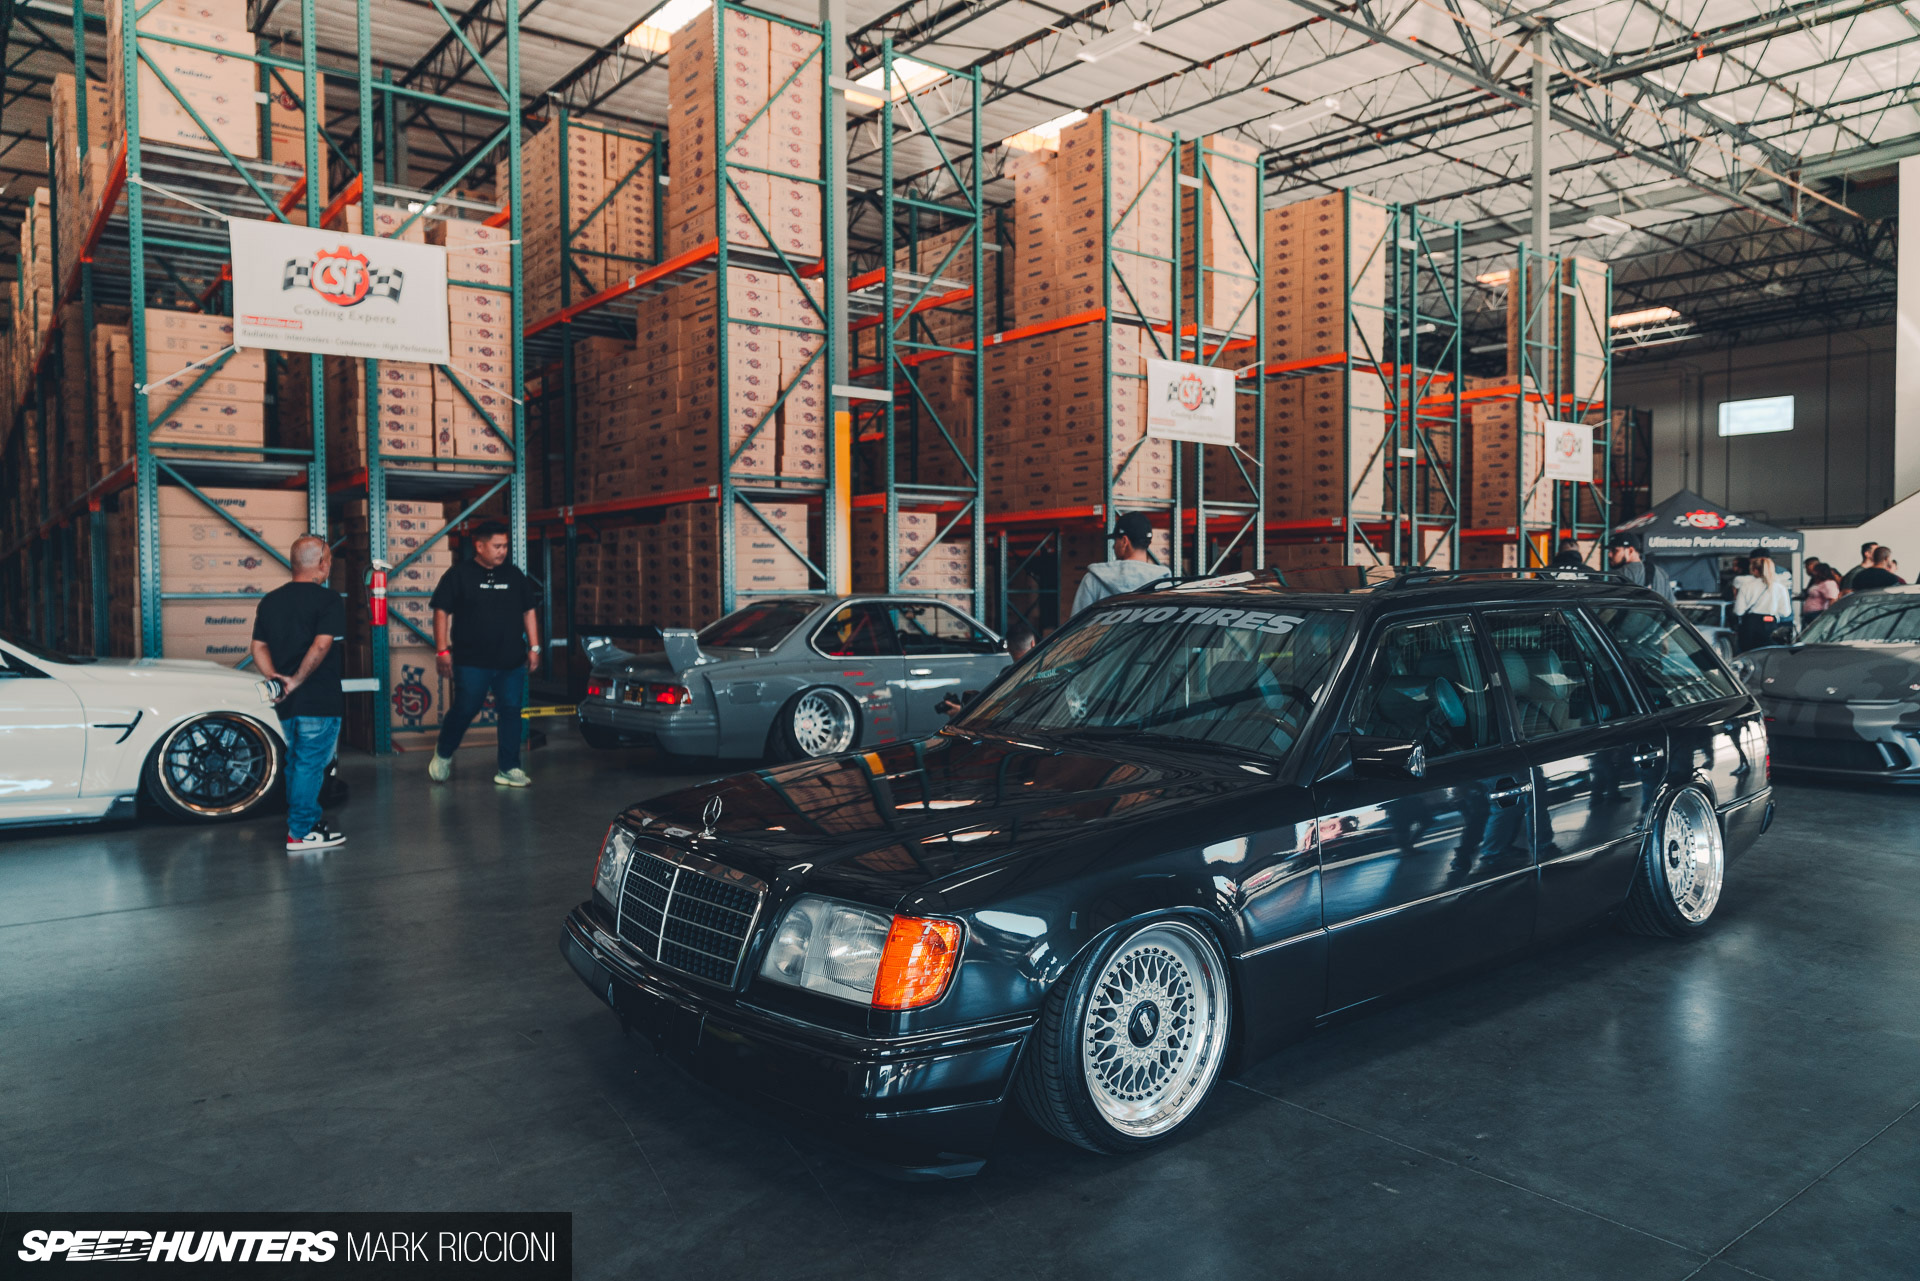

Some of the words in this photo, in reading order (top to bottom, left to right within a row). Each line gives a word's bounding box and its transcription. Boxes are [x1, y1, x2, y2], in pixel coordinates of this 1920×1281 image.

[313, 257, 363, 297] CSF
[294, 304, 344, 321] Cooling
[349, 309, 396, 325] Experts
[242, 329, 279, 339] Radiators
[284, 333, 329, 344] Intercoolers
[400, 343, 444, 355] Performance
[1648, 536, 1692, 548] Ultimate
[1692, 536, 1760, 548] Performance
[1760, 536, 1799, 550] Cooling
[204, 616, 247, 625] Radiator
[1085, 606, 1179, 628] TOYO
[1174, 606, 1305, 634] TIRES
[205, 645, 248, 654] Radiator
